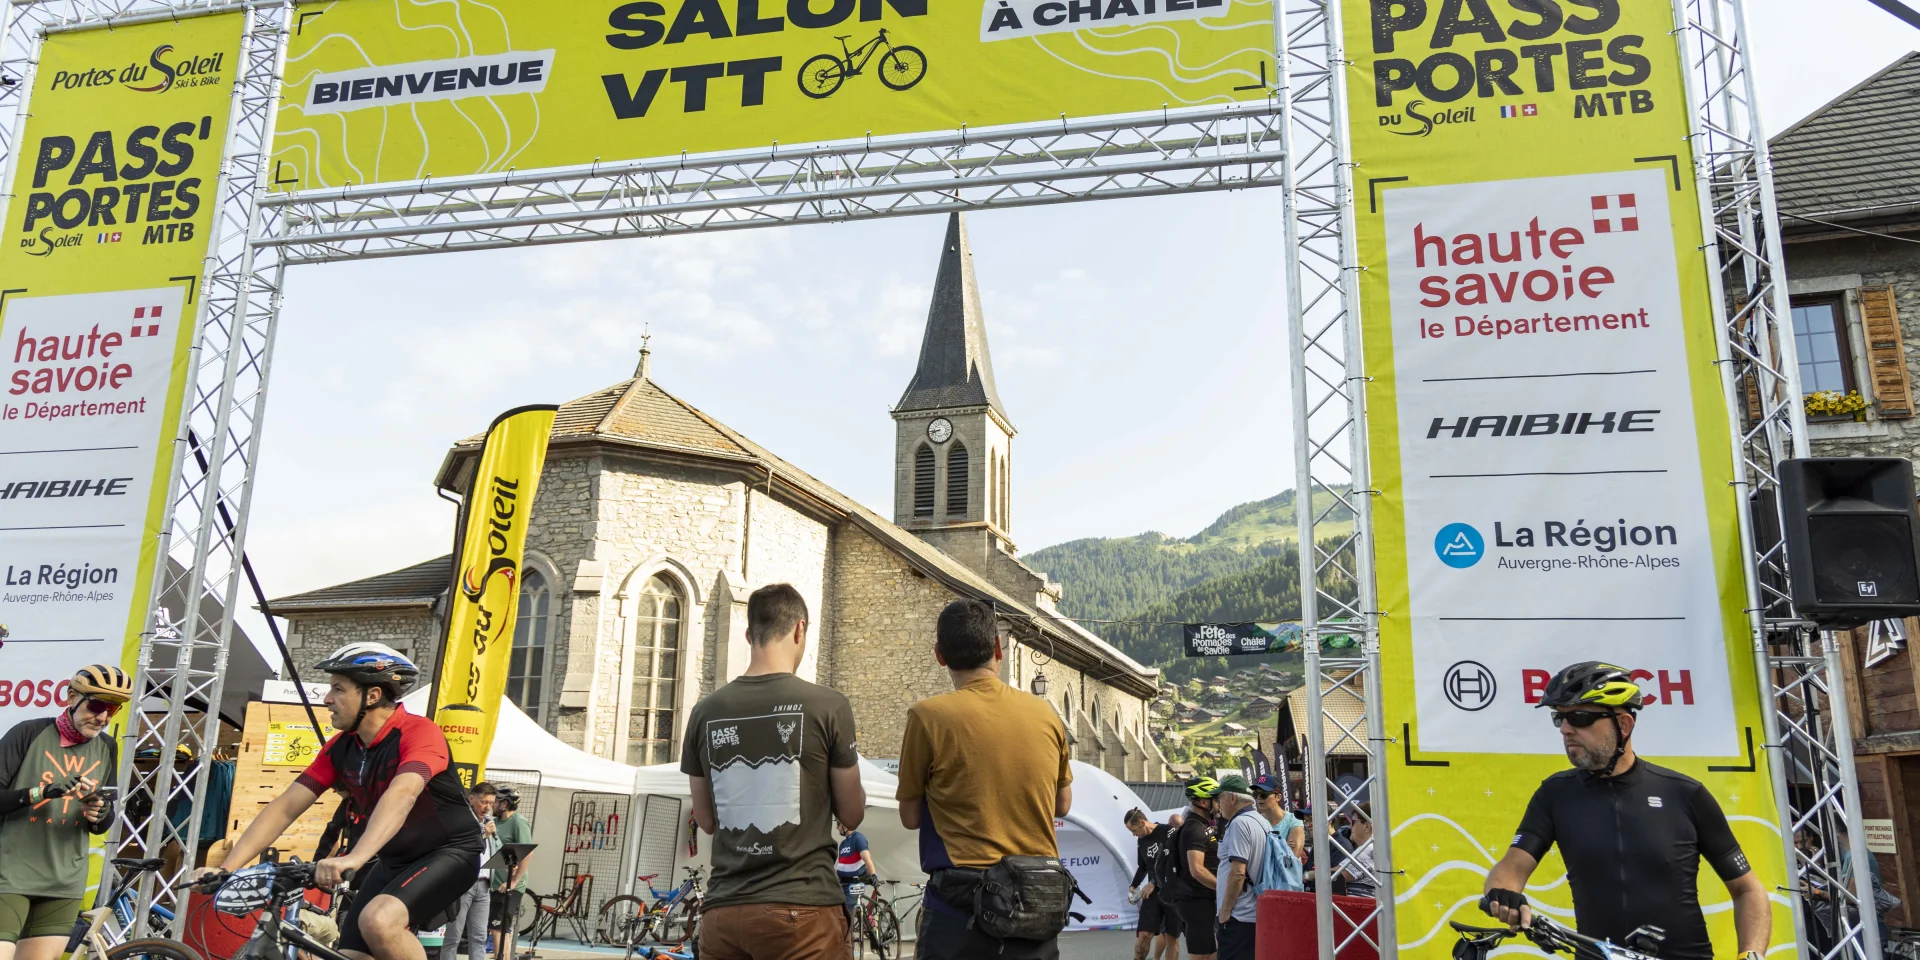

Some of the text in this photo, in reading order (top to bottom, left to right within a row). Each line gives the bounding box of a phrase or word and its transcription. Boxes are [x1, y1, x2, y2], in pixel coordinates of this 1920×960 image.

[51, 44, 224, 94] Portes du Soleil
[174, 76, 221, 89] Ski & Bike
[313, 60, 544, 104] BIENVENUE
[1373, 35, 1651, 107] PORTES
[601, 56, 782, 120] VTT
[1379, 100, 1476, 137] DU Soleil
[1574, 90, 1654, 119] MTB
[32, 116, 212, 188] PASS'
[23, 177, 201, 232] PORTES
[20, 226, 84, 257] DU Soleil
[141, 222, 194, 245] MTB
[1413, 215, 1585, 268] haute
[1419, 265, 1615, 308] savoie
[1420, 308, 1650, 340] le Département
[14, 323, 122, 363] haute
[8, 362, 133, 395] savoie
[2, 397, 147, 421] le Département
[1426, 409, 1661, 439] HAIBIKE
[462, 476, 519, 604] Soleil
[1494, 518, 1677, 553] La Région
[5, 562, 118, 589] La Région
[1497, 555, 1680, 571] Auvergne-Rhône-Alpes
[3, 590, 114, 605] Auvergne-Rhône-Alpes
[1200, 626, 1226, 639] Fête
[0, 679, 71, 708] BOSC
[1521, 668, 1695, 705] BCH
[773, 703, 803, 713] ANIMOZ
[464, 769, 473, 789] MTB
[1070, 855, 1100, 867] FLOW
